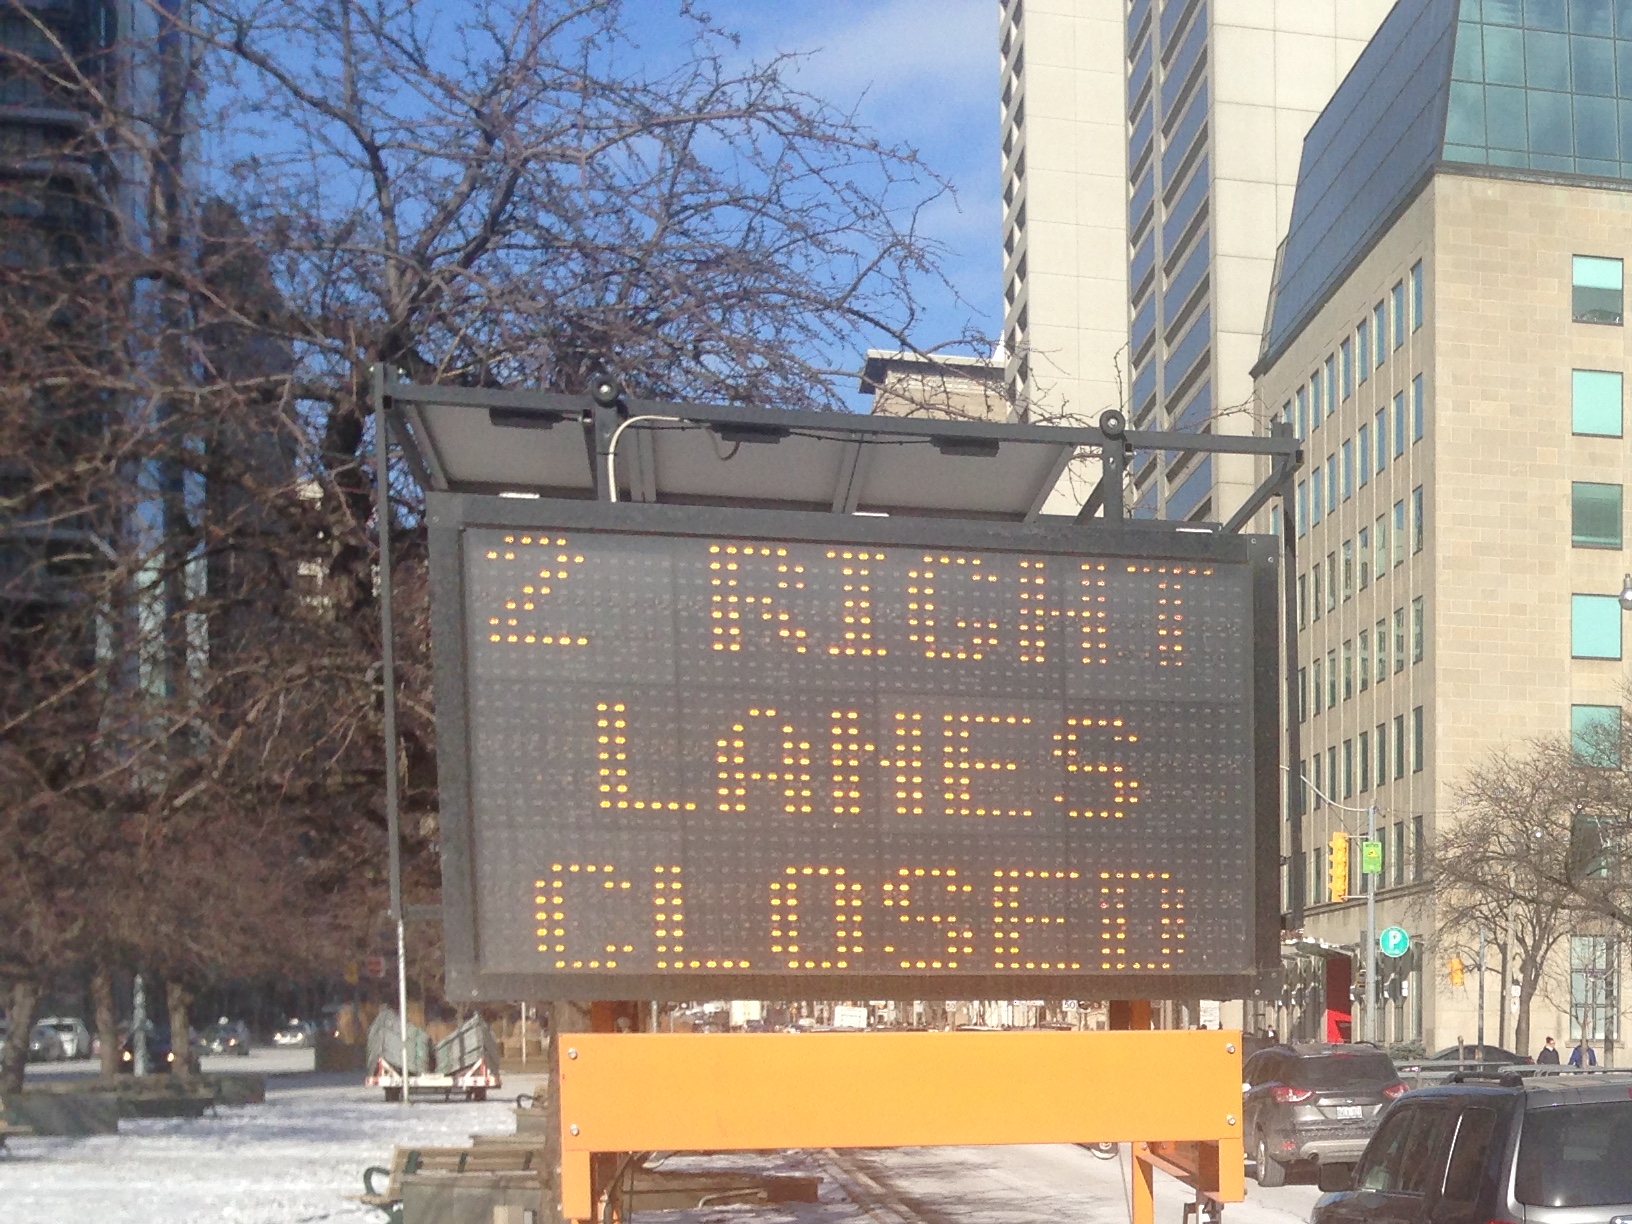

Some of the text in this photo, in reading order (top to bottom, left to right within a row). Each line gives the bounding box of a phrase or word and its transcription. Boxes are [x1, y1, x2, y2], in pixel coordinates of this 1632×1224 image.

[486, 534, 1215, 668] 2 RIGHT
[596, 702, 1140, 820] LANES
[533, 862, 1187, 970] CLOSED
[1388, 930, 1402, 949] P
